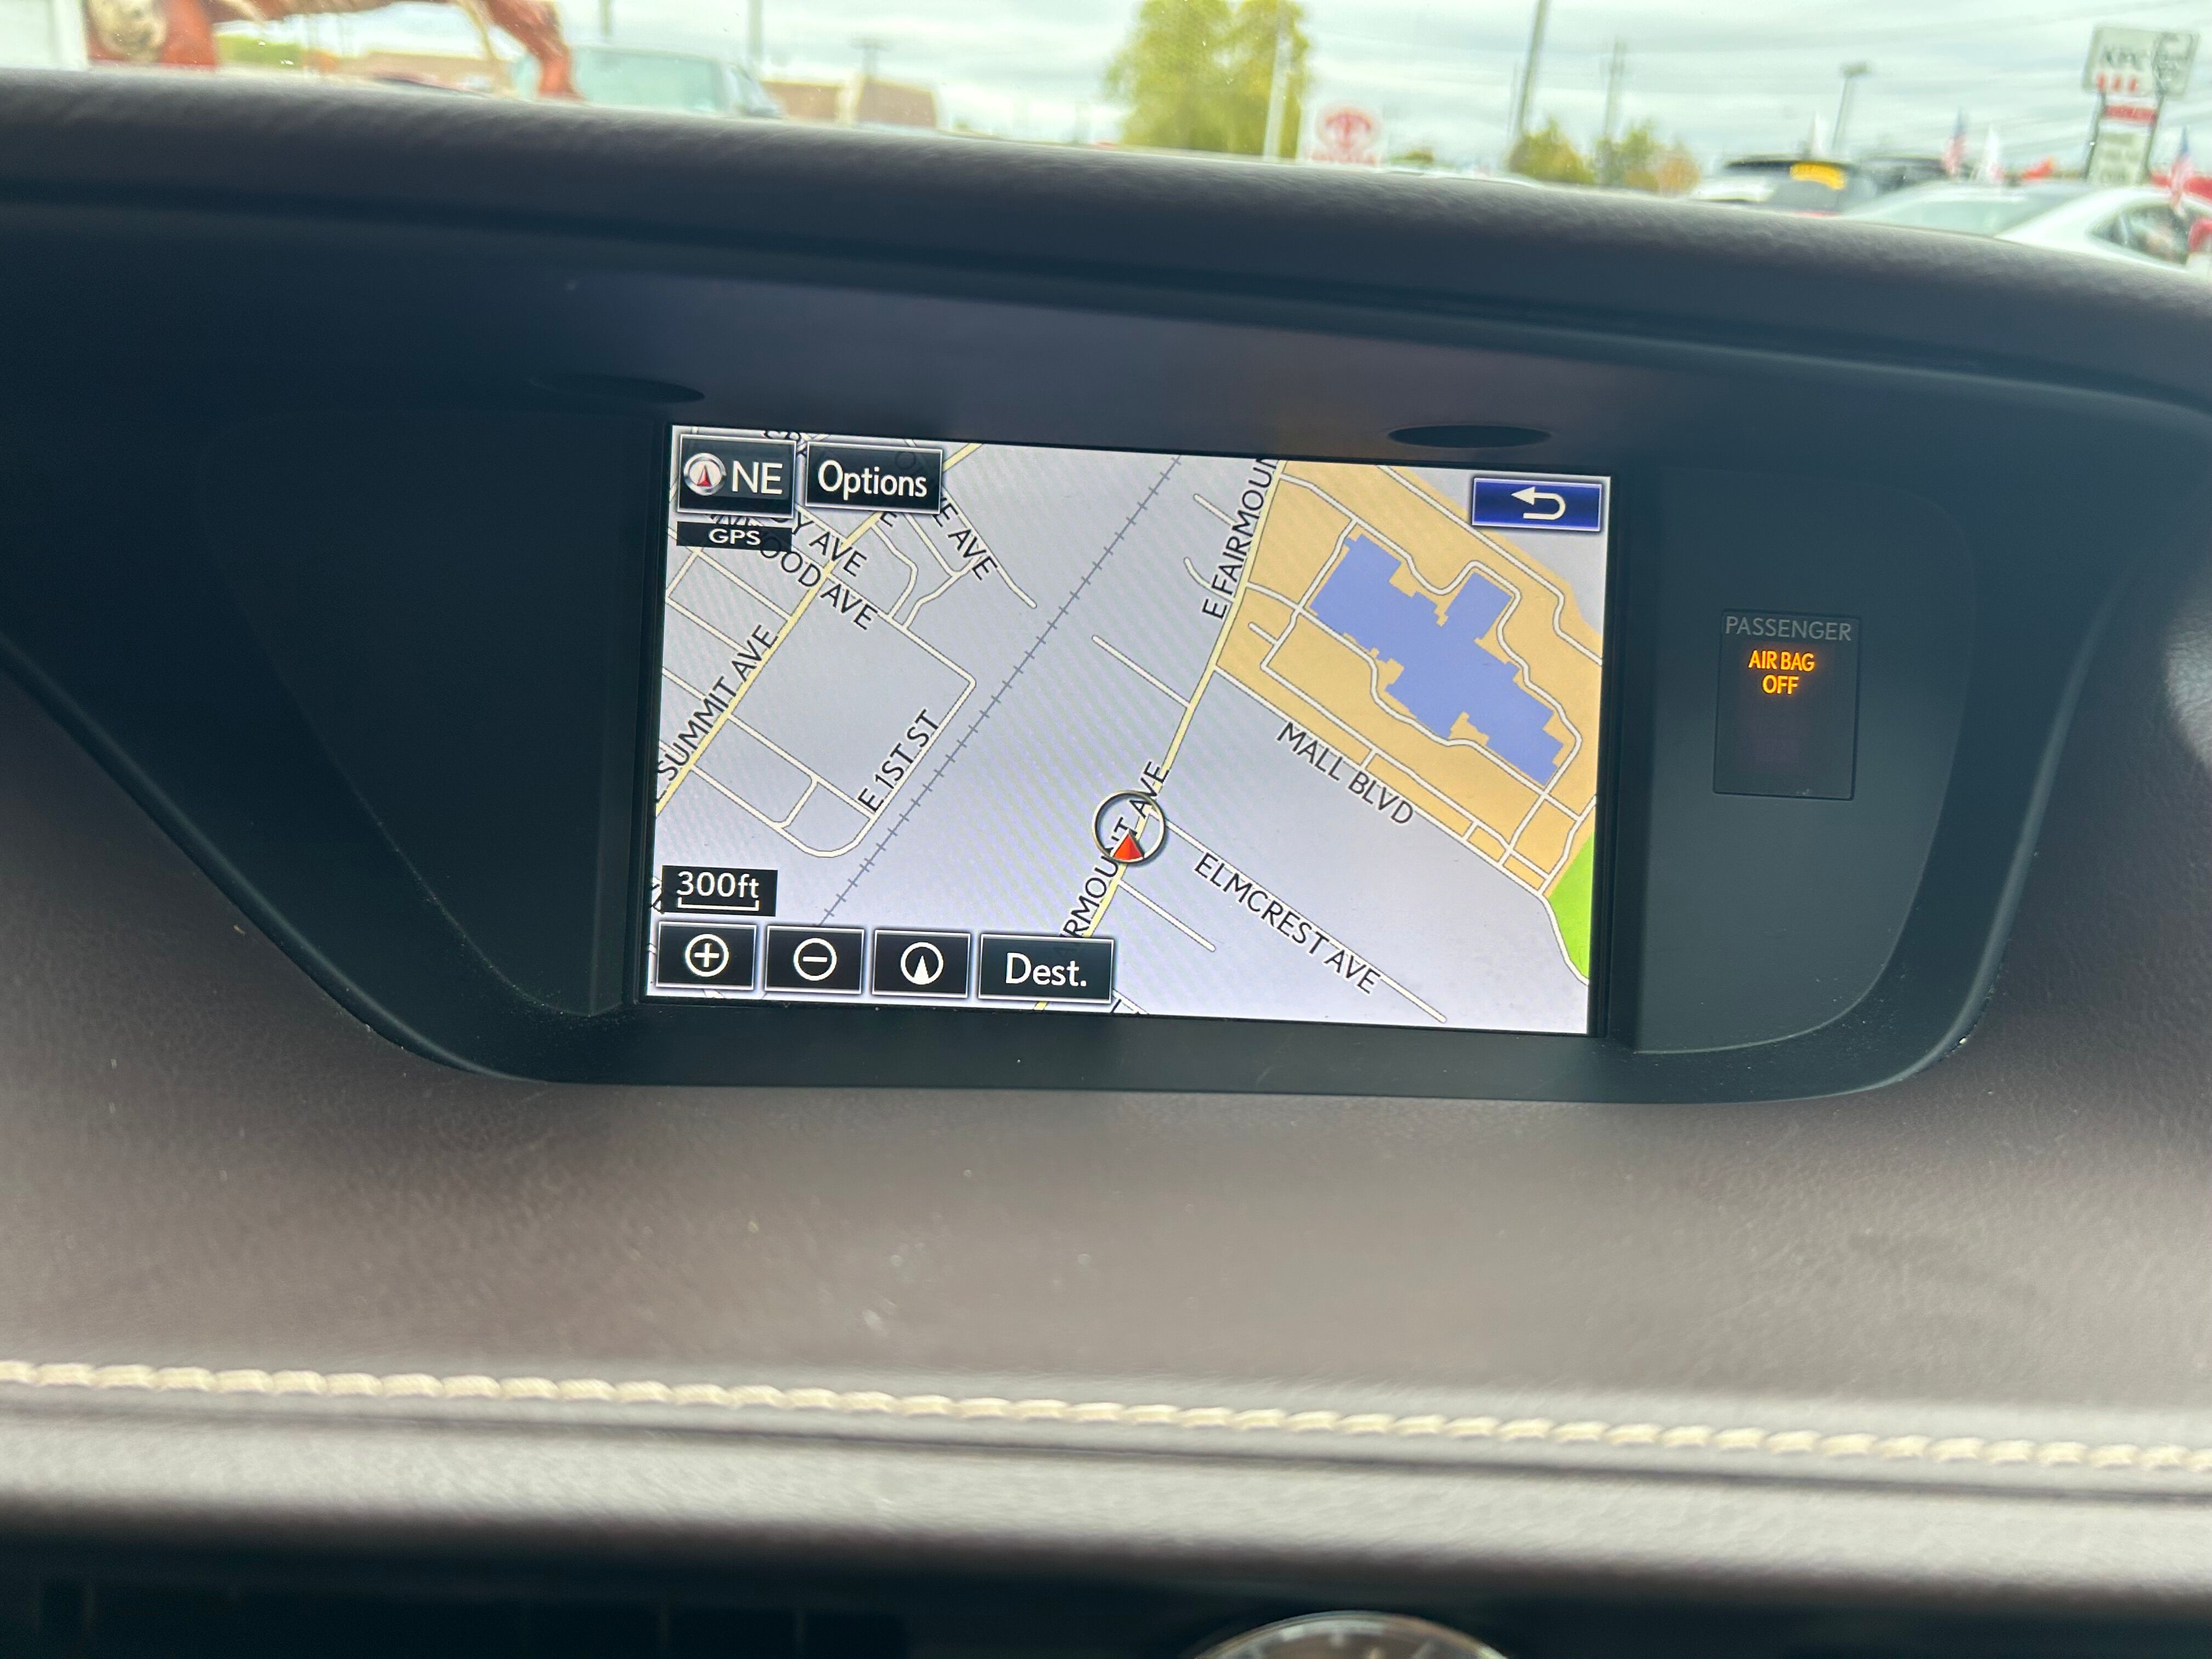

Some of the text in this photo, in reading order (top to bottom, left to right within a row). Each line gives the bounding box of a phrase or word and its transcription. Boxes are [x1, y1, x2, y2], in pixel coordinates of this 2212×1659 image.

[732, 460, 783, 495] NE
[818, 459, 928, 501] Options
[708, 528, 763, 546] GPS
[809, 532, 867, 577] AVE
[947, 529, 998, 581] AVE
[820, 584, 878, 631] AVE
[1201, 598, 1228, 620] E
[1725, 616, 1852, 641] PASSENGER
[1748, 650, 1816, 672] AIR BAG
[657, 624, 778, 782] SUMMIT AVE
[1762, 674, 1799, 695] OFF
[857, 709, 939, 812] E 1ST ST
[1276, 722, 1414, 825] MALL BLVD
[1129, 761, 1170, 819] AVE
[676, 870, 760, 899] 300ft
[1194, 852, 1382, 995] ELMCREST AVE
[1005, 952, 1087, 987] Dest.
